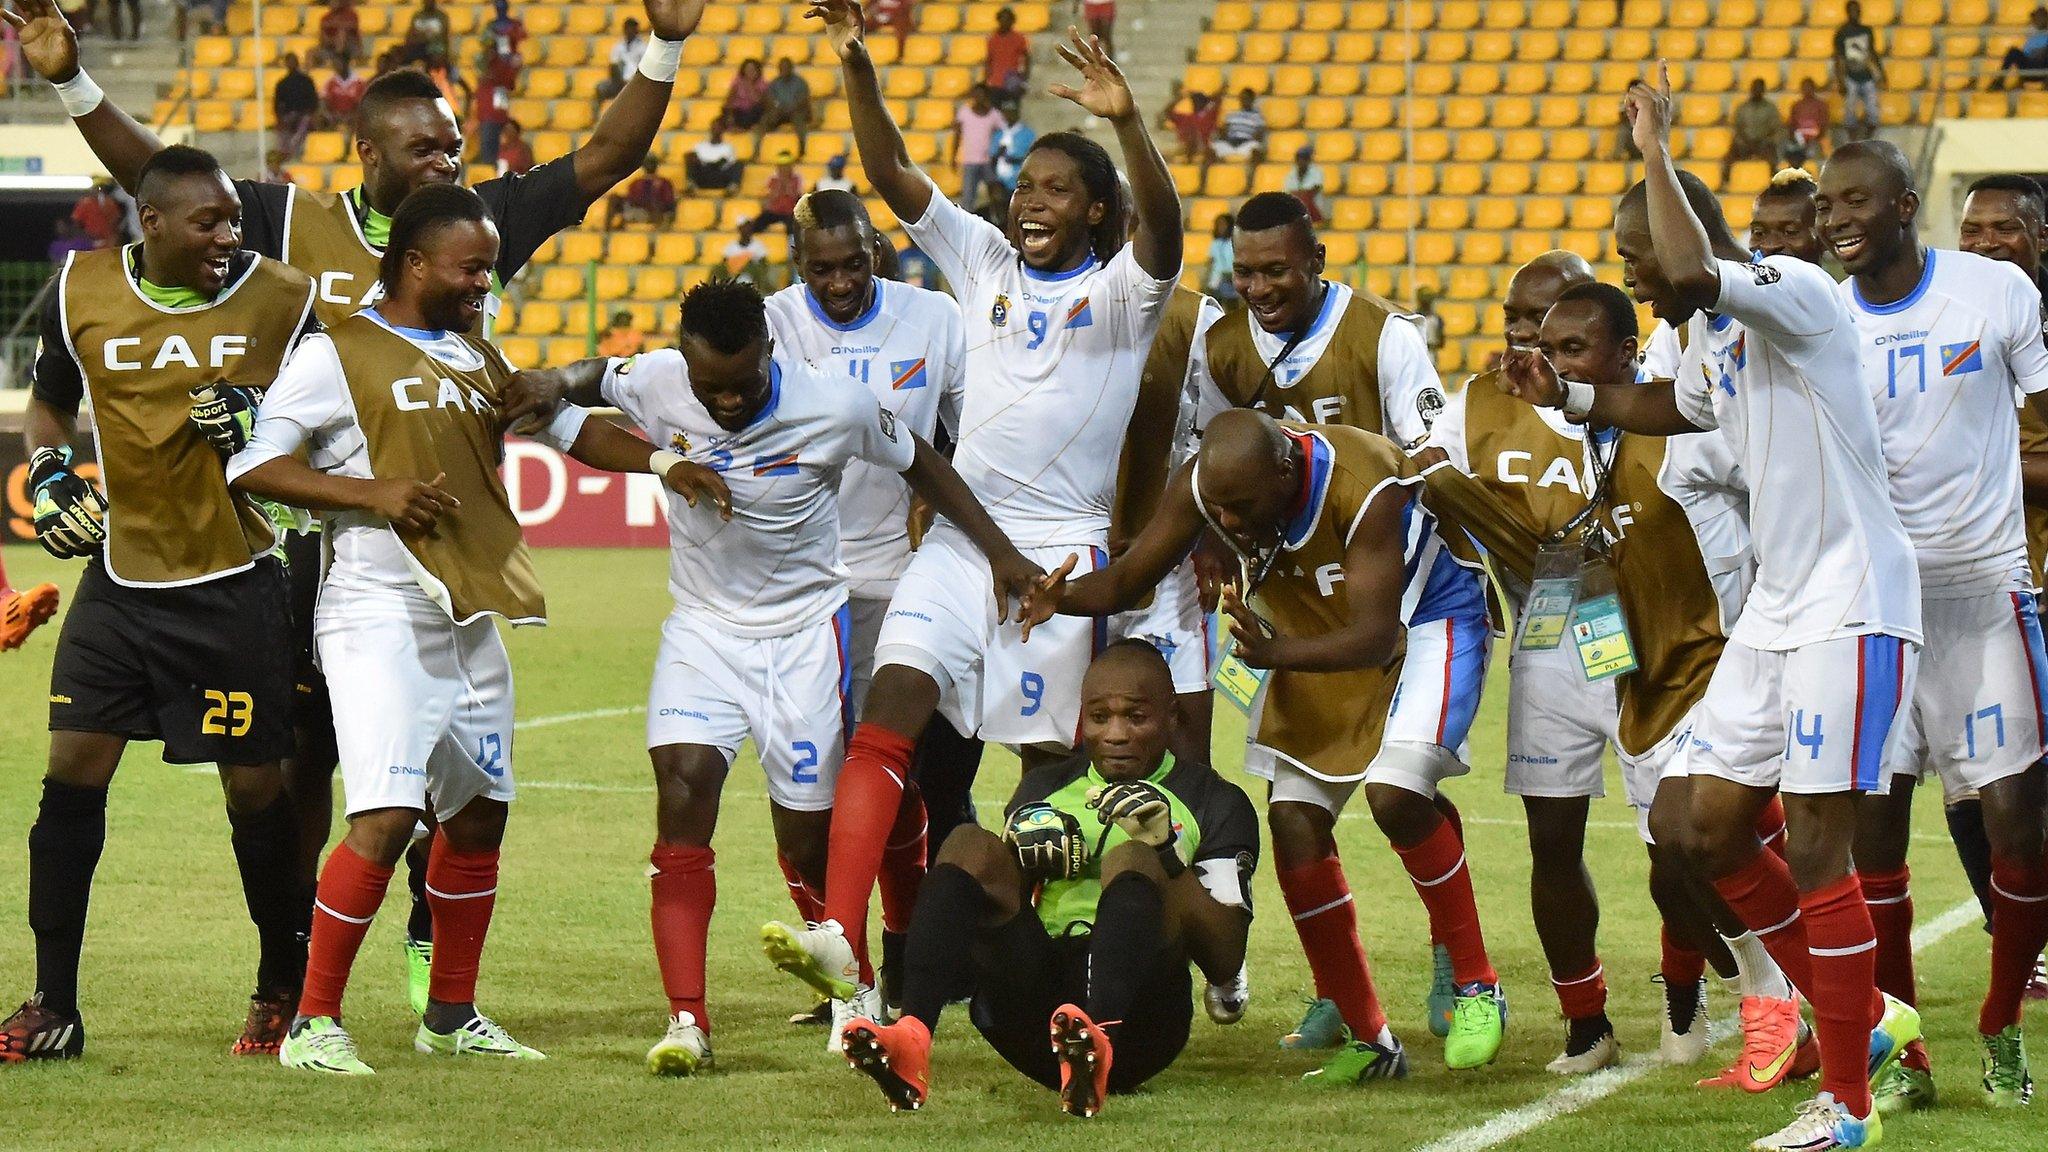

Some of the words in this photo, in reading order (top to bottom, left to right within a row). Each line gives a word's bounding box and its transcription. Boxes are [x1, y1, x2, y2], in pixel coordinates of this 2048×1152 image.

[320, 271, 386, 306] CA
[1027, 311, 1047, 350] 9
[1874, 330, 1929, 346] O'Neills
[103, 335, 247, 371] CAF
[1887, 344, 1926, 398] 17
[1497, 450, 1582, 495] CA
[69, 504, 103, 540] uhlsport
[1604, 661, 1620, 671] PLA
[202, 689, 254, 737] 23
[659, 707, 709, 722] O'Neills
[1020, 671, 1045, 717] 9
[1785, 708, 1824, 761] 14
[1965, 703, 2005, 759] 17
[476, 732, 504, 777] 12
[791, 740, 818, 784] 2
